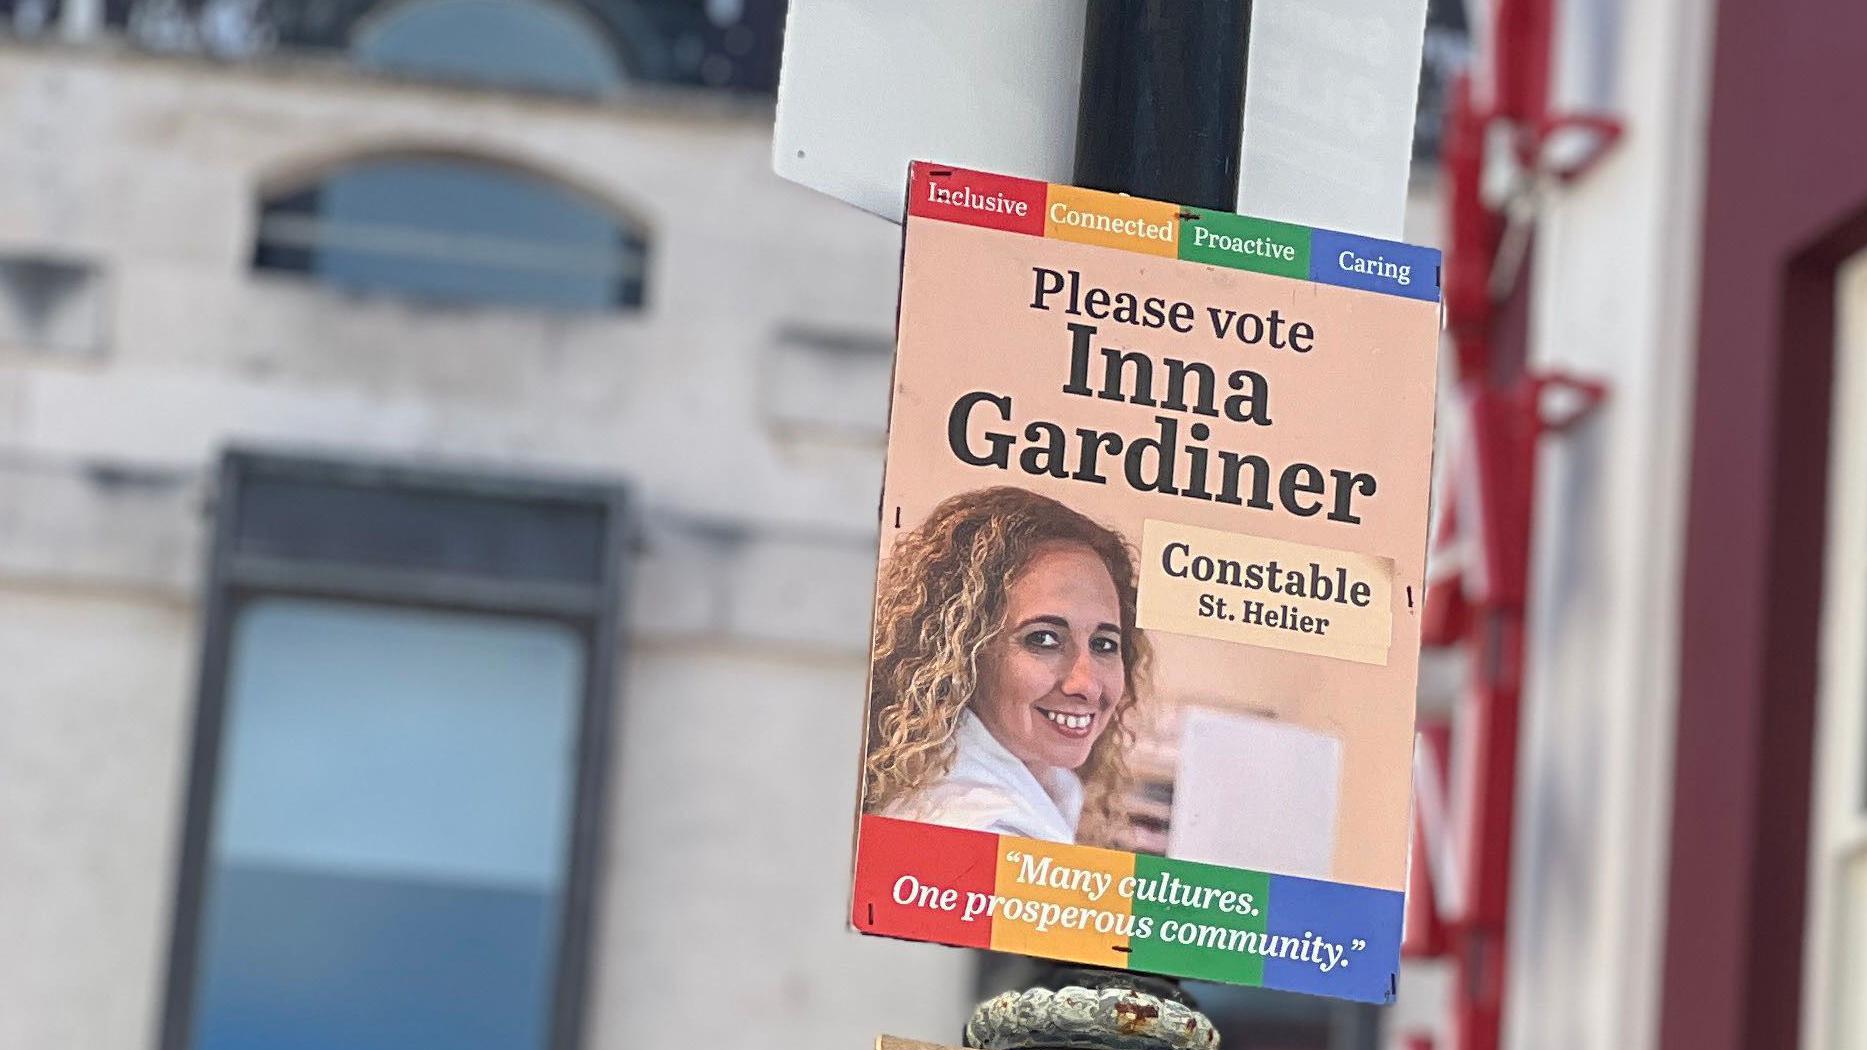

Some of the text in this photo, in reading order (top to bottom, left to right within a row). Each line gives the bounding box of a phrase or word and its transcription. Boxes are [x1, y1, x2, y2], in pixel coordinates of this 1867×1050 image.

[928, 182, 1412, 285] Inclusive Connected Proactive Caring
[1030, 267, 1315, 353] Please vote
[1062, 323, 1273, 427] Inna
[947, 392, 1377, 525] Gardiner
[1162, 542, 1371, 607] Constable
[1198, 594, 1330, 635] St. Helier
[892, 874, 1367, 972] One prosperous community.”
[1005, 850, 1260, 917] “Many cultures.
